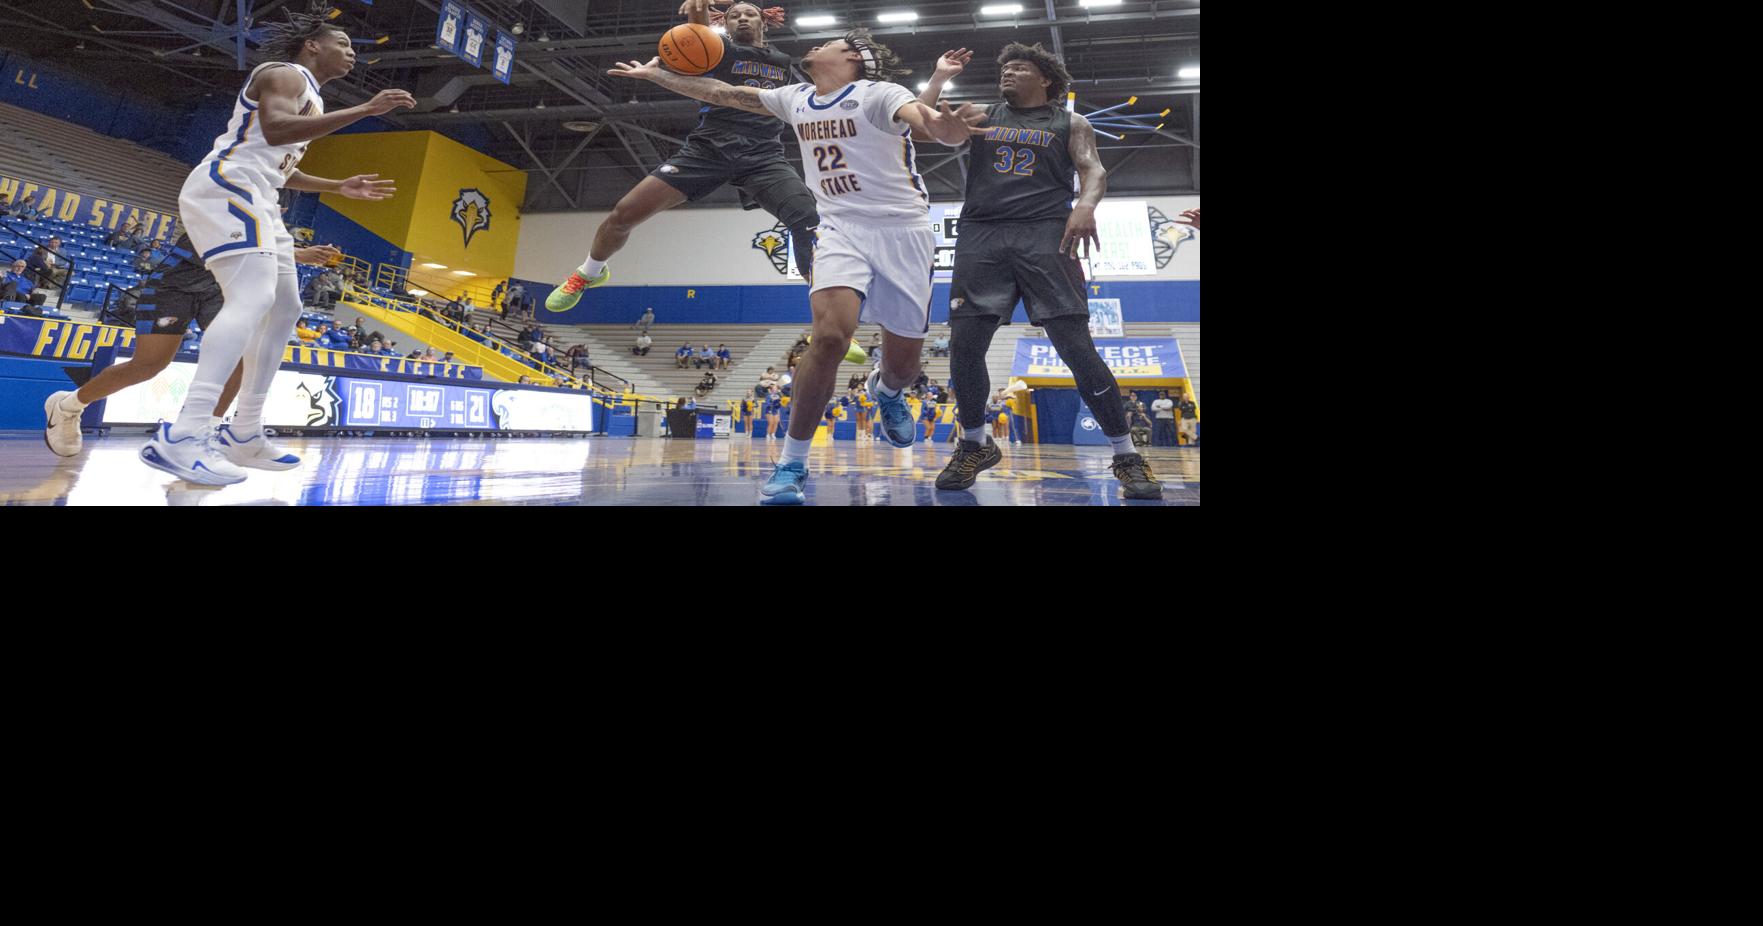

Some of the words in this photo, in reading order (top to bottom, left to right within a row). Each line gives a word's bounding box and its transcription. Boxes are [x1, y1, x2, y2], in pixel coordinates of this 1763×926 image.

[731, 60, 786, 80] MIDWAY
[797, 118, 858, 141] MOREHEAD
[984, 126, 1056, 148] MIDWAY
[814, 144, 848, 172] 22
[994, 145, 1036, 176] 32
[820, 173, 862, 197] STATE
[88, 199, 173, 241] STATE
[687, 289, 696, 299] R
[1090, 285, 1101, 296] T
[352, 386, 376, 419] 18
[469, 394, 485, 423] 21
